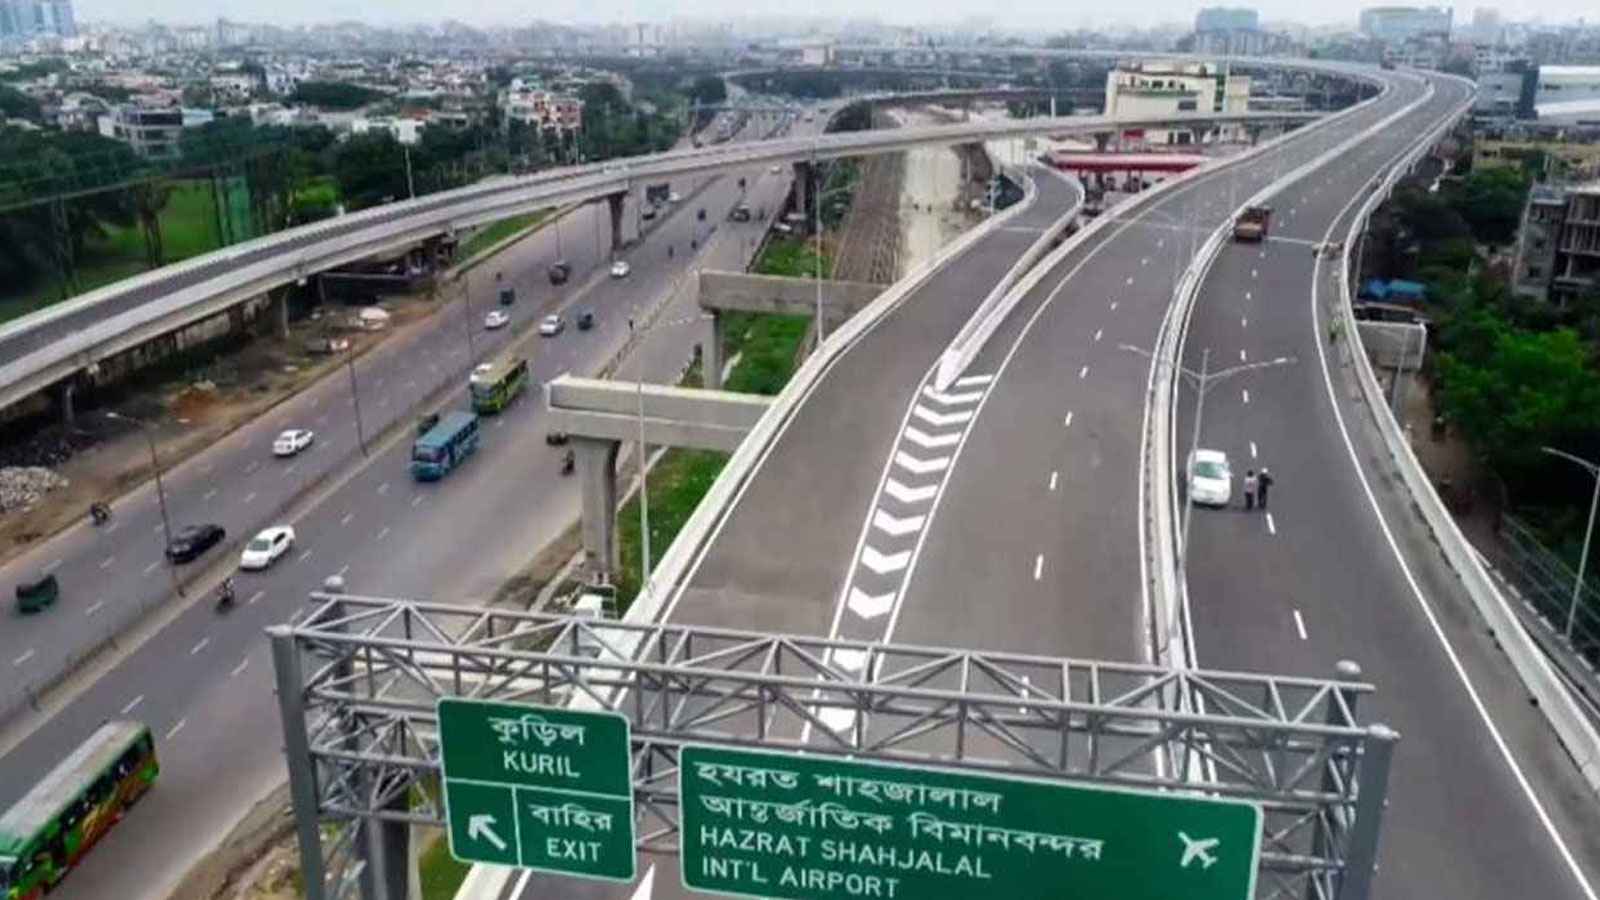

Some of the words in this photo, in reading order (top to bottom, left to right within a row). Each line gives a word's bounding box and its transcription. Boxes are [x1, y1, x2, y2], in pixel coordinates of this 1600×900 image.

[489, 713, 586, 747] কুড়িল
[502, 750, 581, 780] KURIL
[815, 773, 1004, 814] শাহজালাল
[529, 802, 614, 832] বাহির
[701, 791, 895, 835] আন্তর্জাতিক
[909, 812, 1105, 863] বিমানবন্দর
[546, 838, 603, 863] EXIT
[700, 825, 809, 857] HAZRAT
[819, 837, 993, 880] SHAHJALAL
[701, 856, 769, 884] INT'L
[778, 866, 902, 898] AIRPORT
